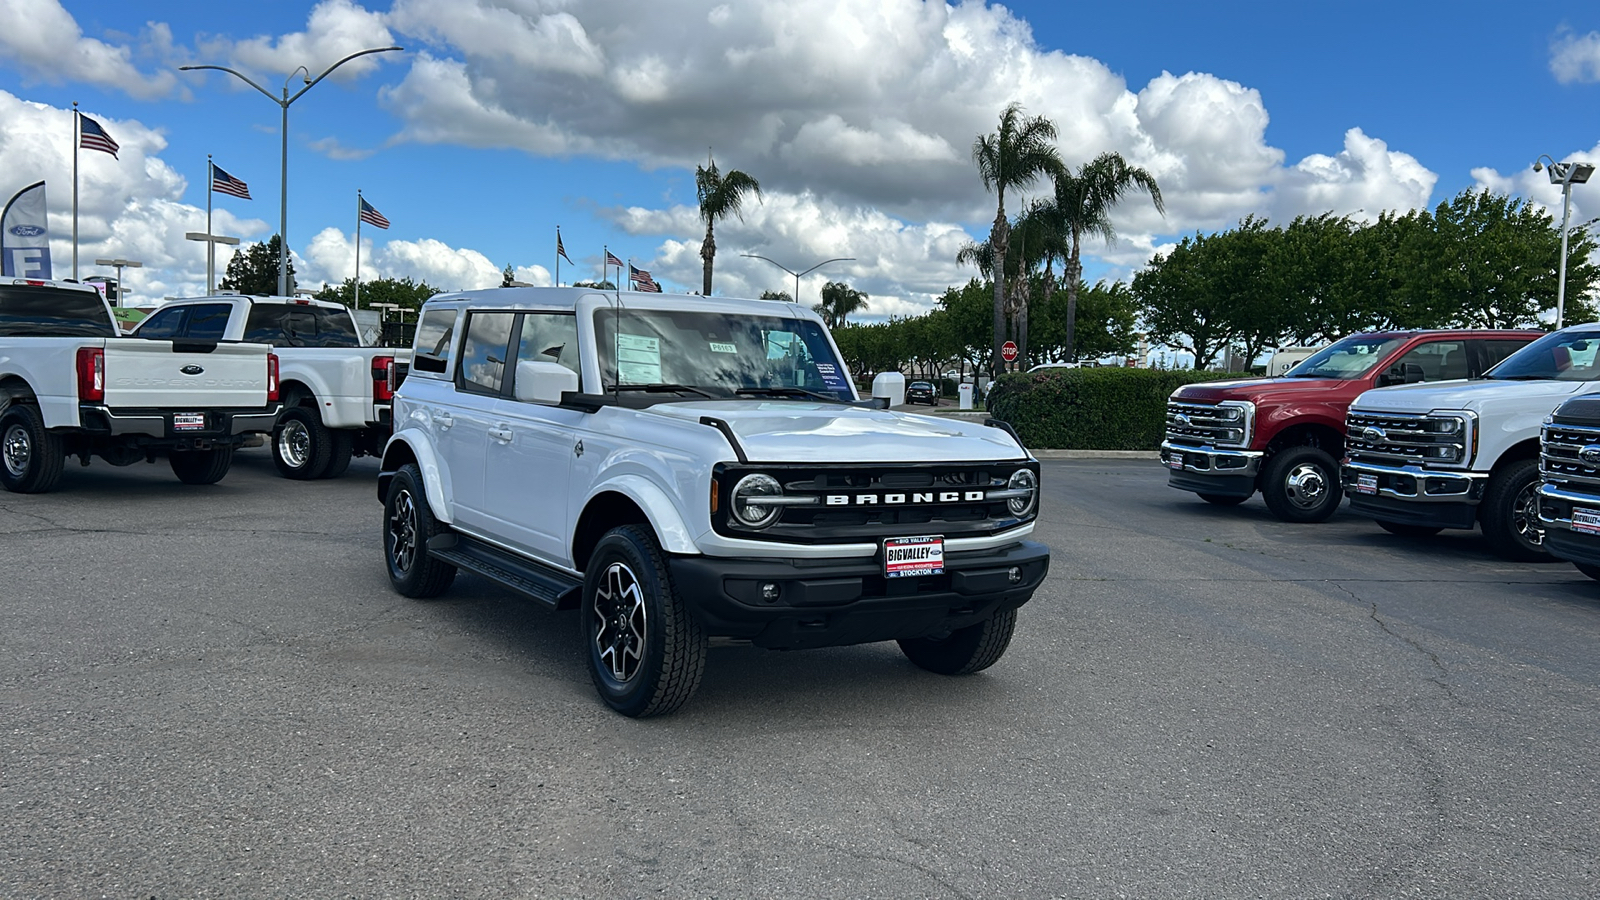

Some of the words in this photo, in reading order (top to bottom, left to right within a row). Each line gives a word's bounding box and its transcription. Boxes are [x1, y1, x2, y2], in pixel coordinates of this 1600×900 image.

[15, 226, 39, 236] Ford
[116, 377, 198, 387] SUPER
[205, 378, 261, 387] DUTY
[826, 491, 984, 505] BRONCO
[888, 547, 931, 562] BIGVALLEY
[900, 569, 932, 577] STOCKTON
